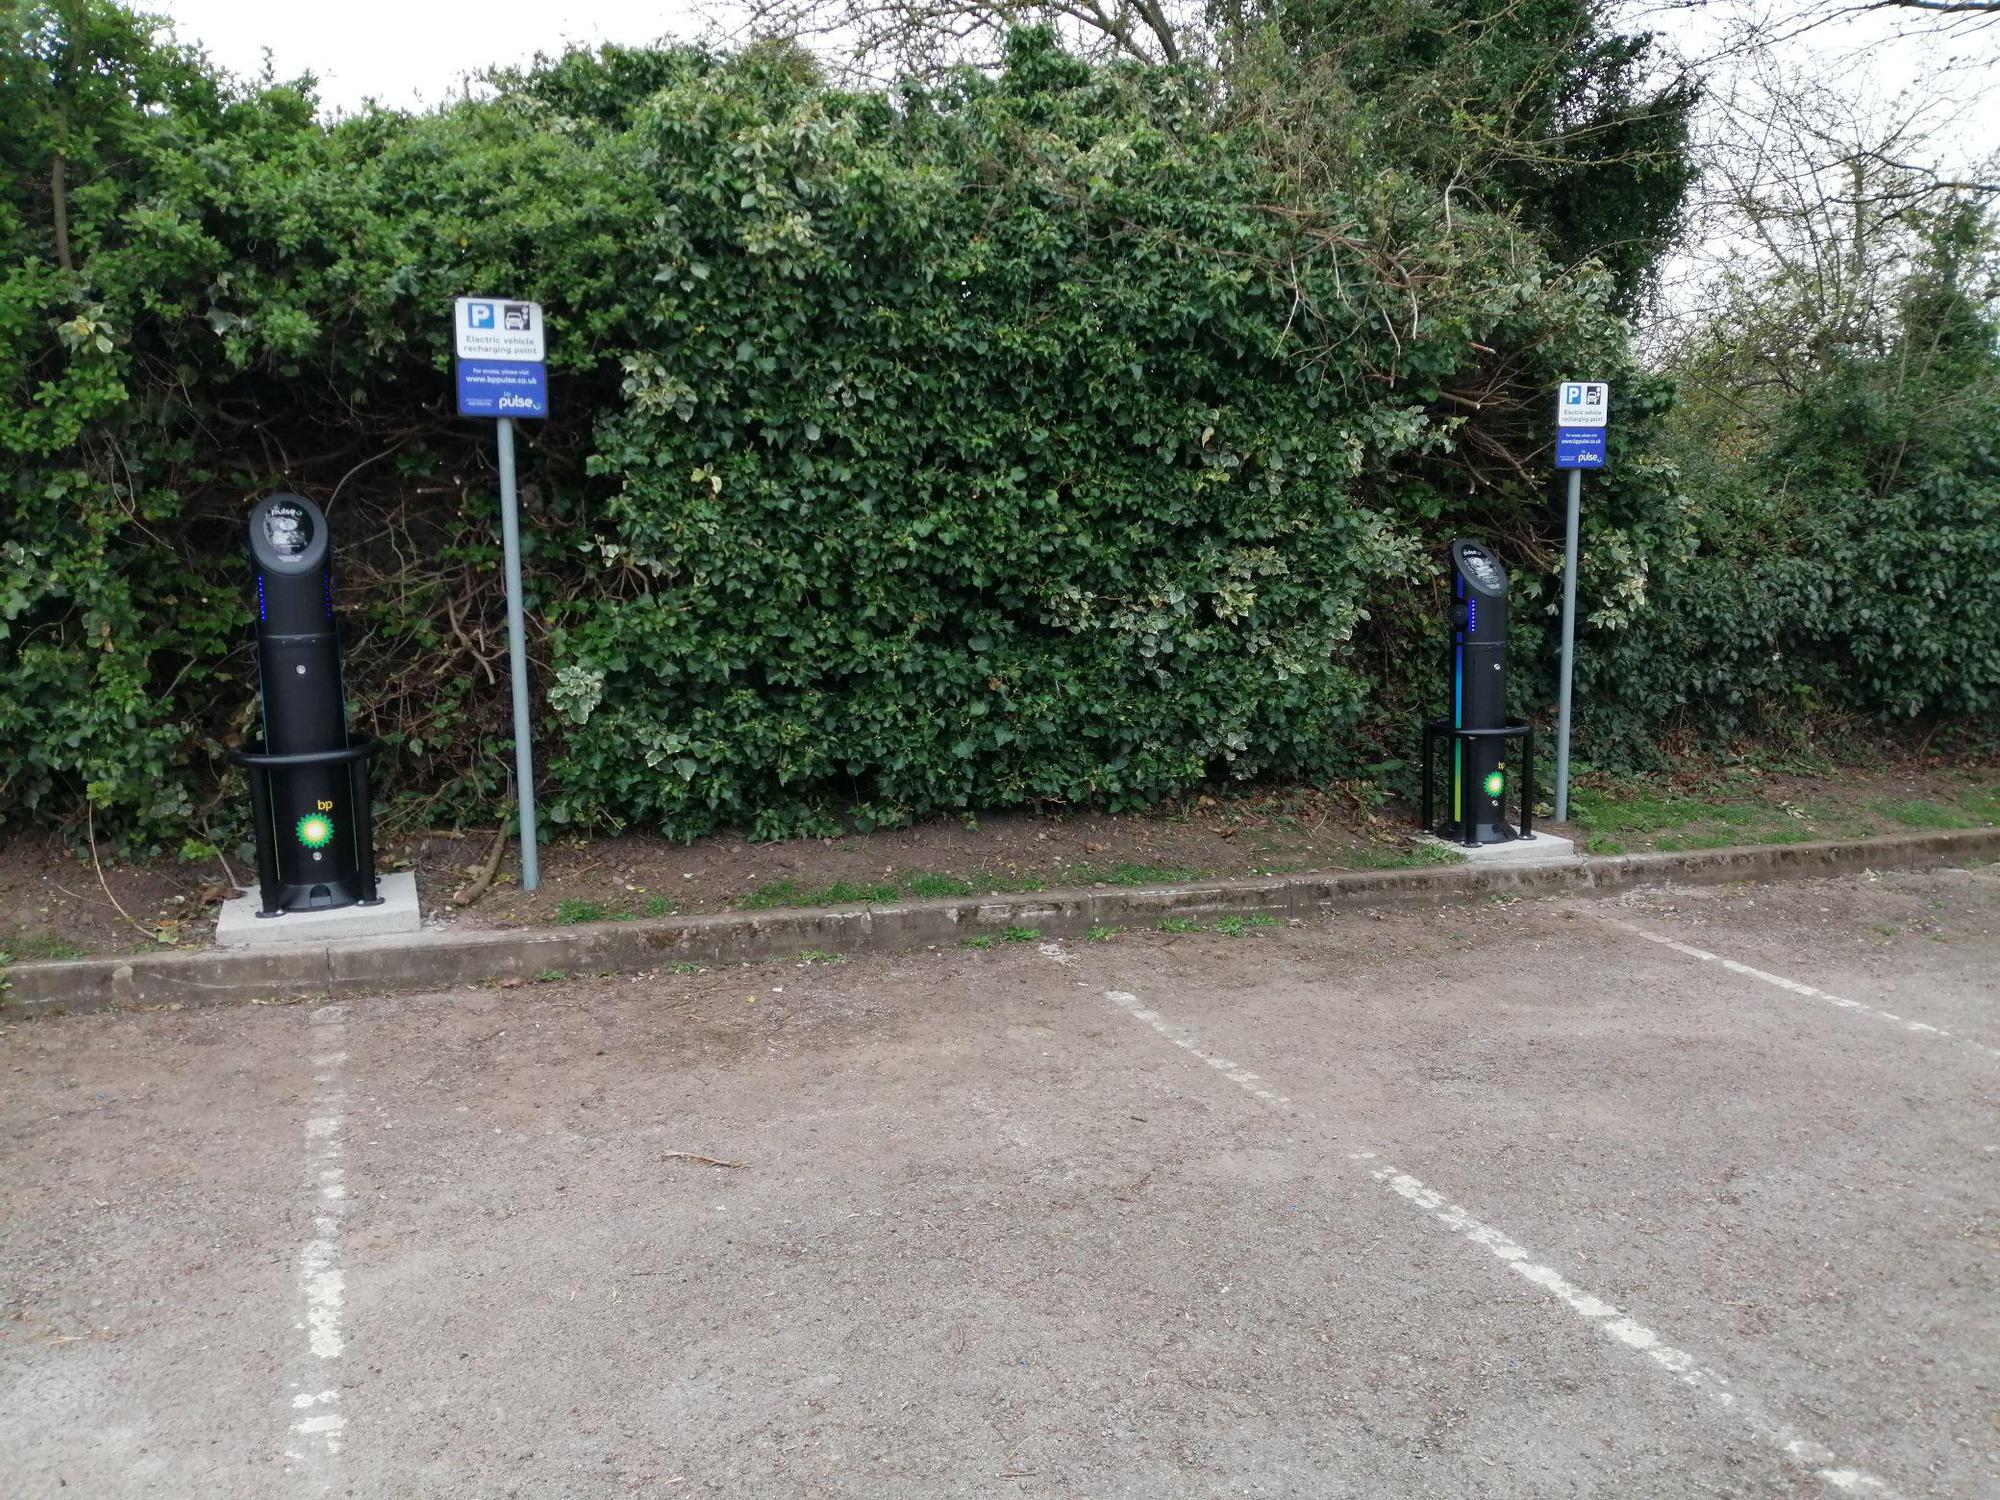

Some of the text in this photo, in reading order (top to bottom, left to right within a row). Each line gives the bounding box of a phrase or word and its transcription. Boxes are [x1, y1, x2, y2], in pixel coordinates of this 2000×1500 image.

[472, 305, 489, 327] P
[466, 335, 534, 346] Electric vehicle
[464, 345, 537, 355] recharging point
[465, 375, 537, 385] www.bppulse.co.uk
[1568, 387, 1580, 404] P
[498, 394, 533, 410] pulse
[1578, 451, 1598, 463] pulse
[271, 507, 296, 516] pulse
[317, 800, 333, 811] bp
